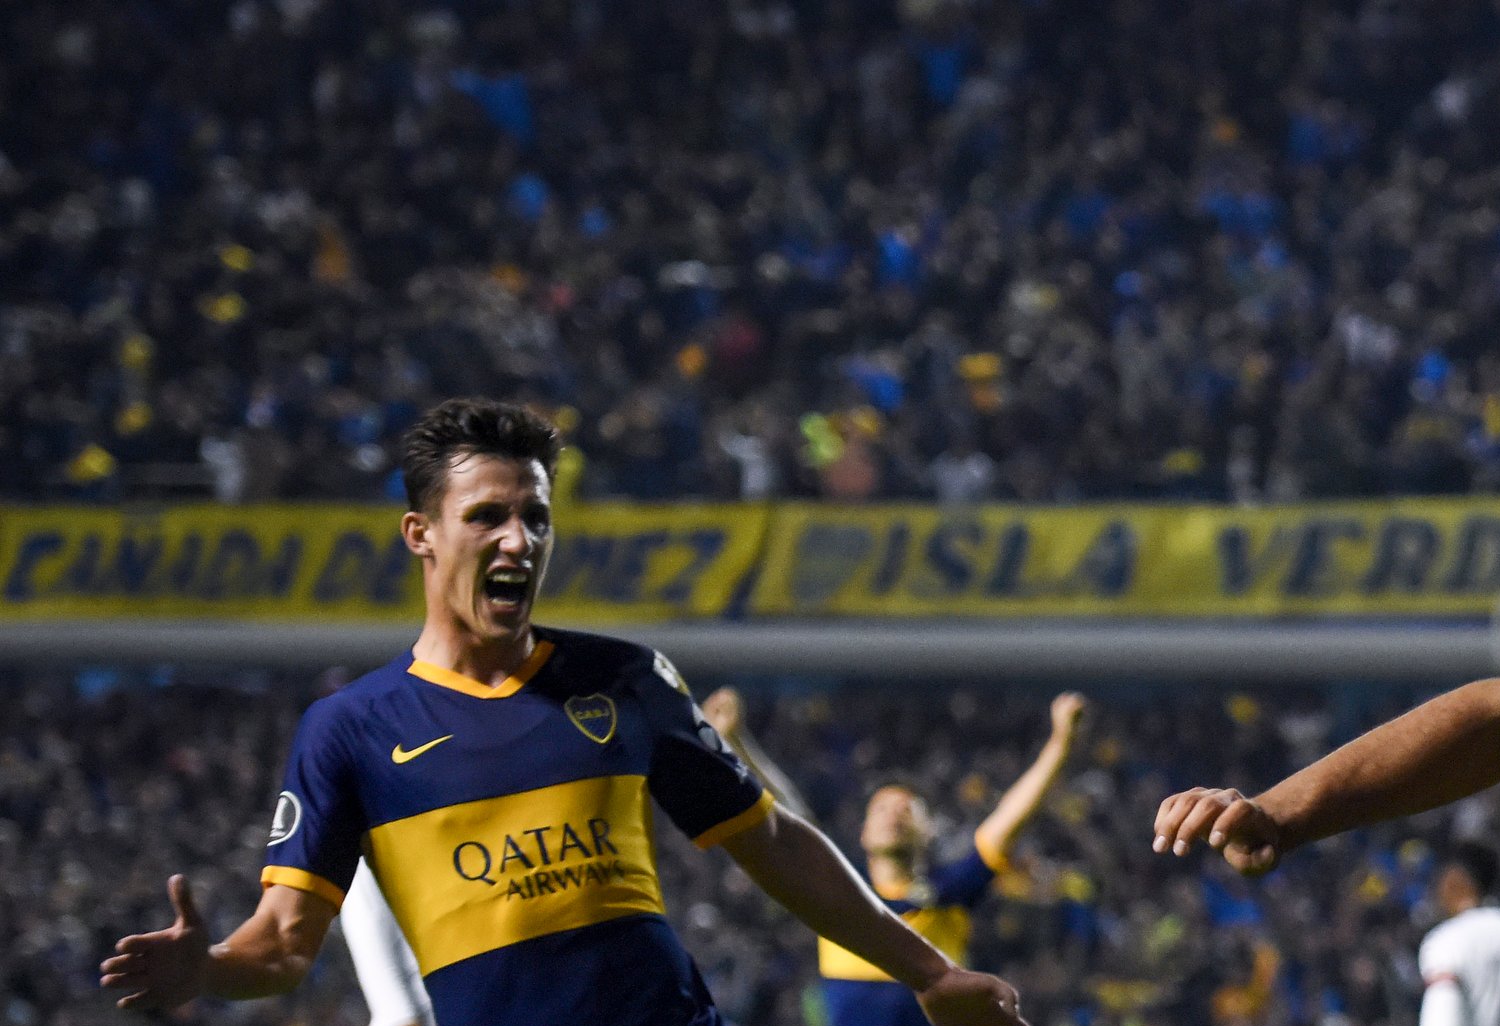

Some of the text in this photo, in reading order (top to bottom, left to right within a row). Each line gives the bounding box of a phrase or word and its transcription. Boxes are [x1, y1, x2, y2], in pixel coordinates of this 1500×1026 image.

[866, 519, 1138, 597] ISLA
[452, 818, 620, 887] QATAR
[506, 858, 627, 901] AIRWAYS
